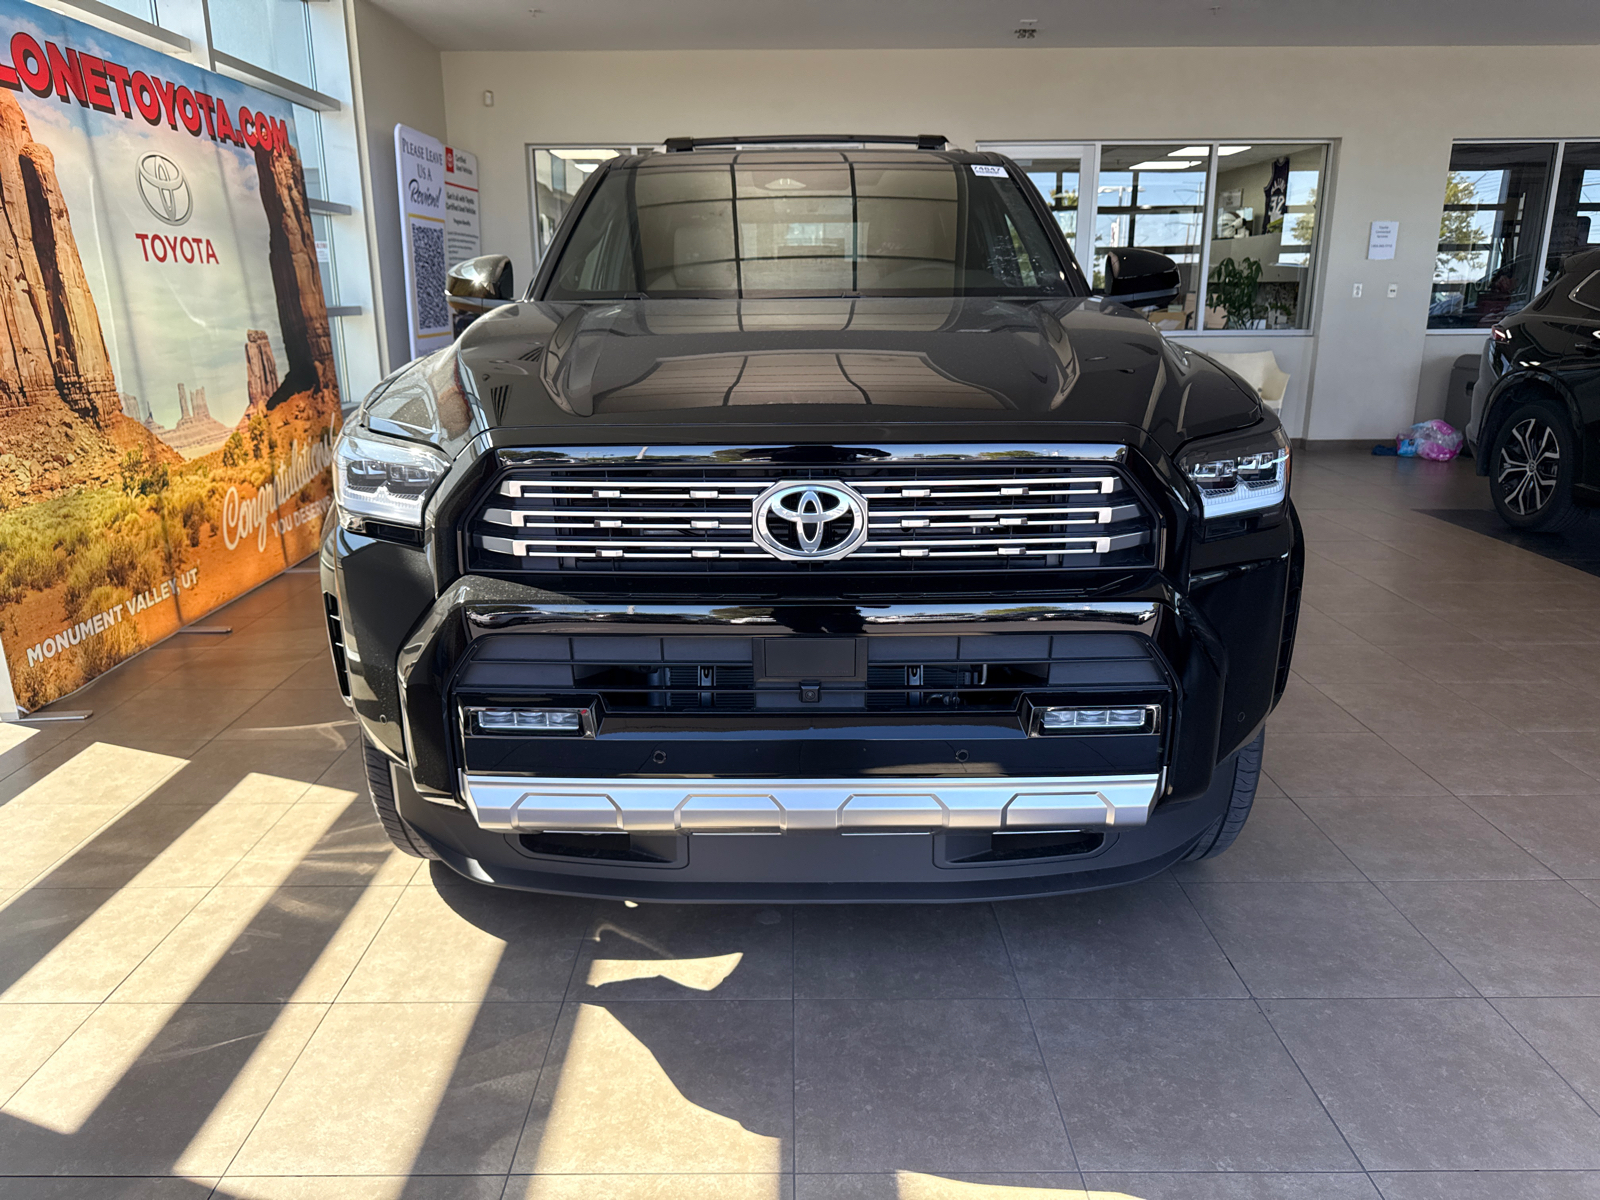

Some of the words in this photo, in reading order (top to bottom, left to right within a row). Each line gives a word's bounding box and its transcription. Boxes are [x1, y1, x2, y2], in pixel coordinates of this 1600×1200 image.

[402, 138, 424, 160] PLEASE
[425, 147, 443, 166] LEAVE
[427, 167, 433, 182] A
[408, 178, 442, 208] Review!
[1268, 195, 1285, 216] 32
[135, 233, 220, 265] TOYOTA
[271, 514, 293, 538] YOU
[26, 605, 123, 668] MONUMENT
[125, 576, 181, 616] VALLEY,
[181, 567, 199, 590] UT
